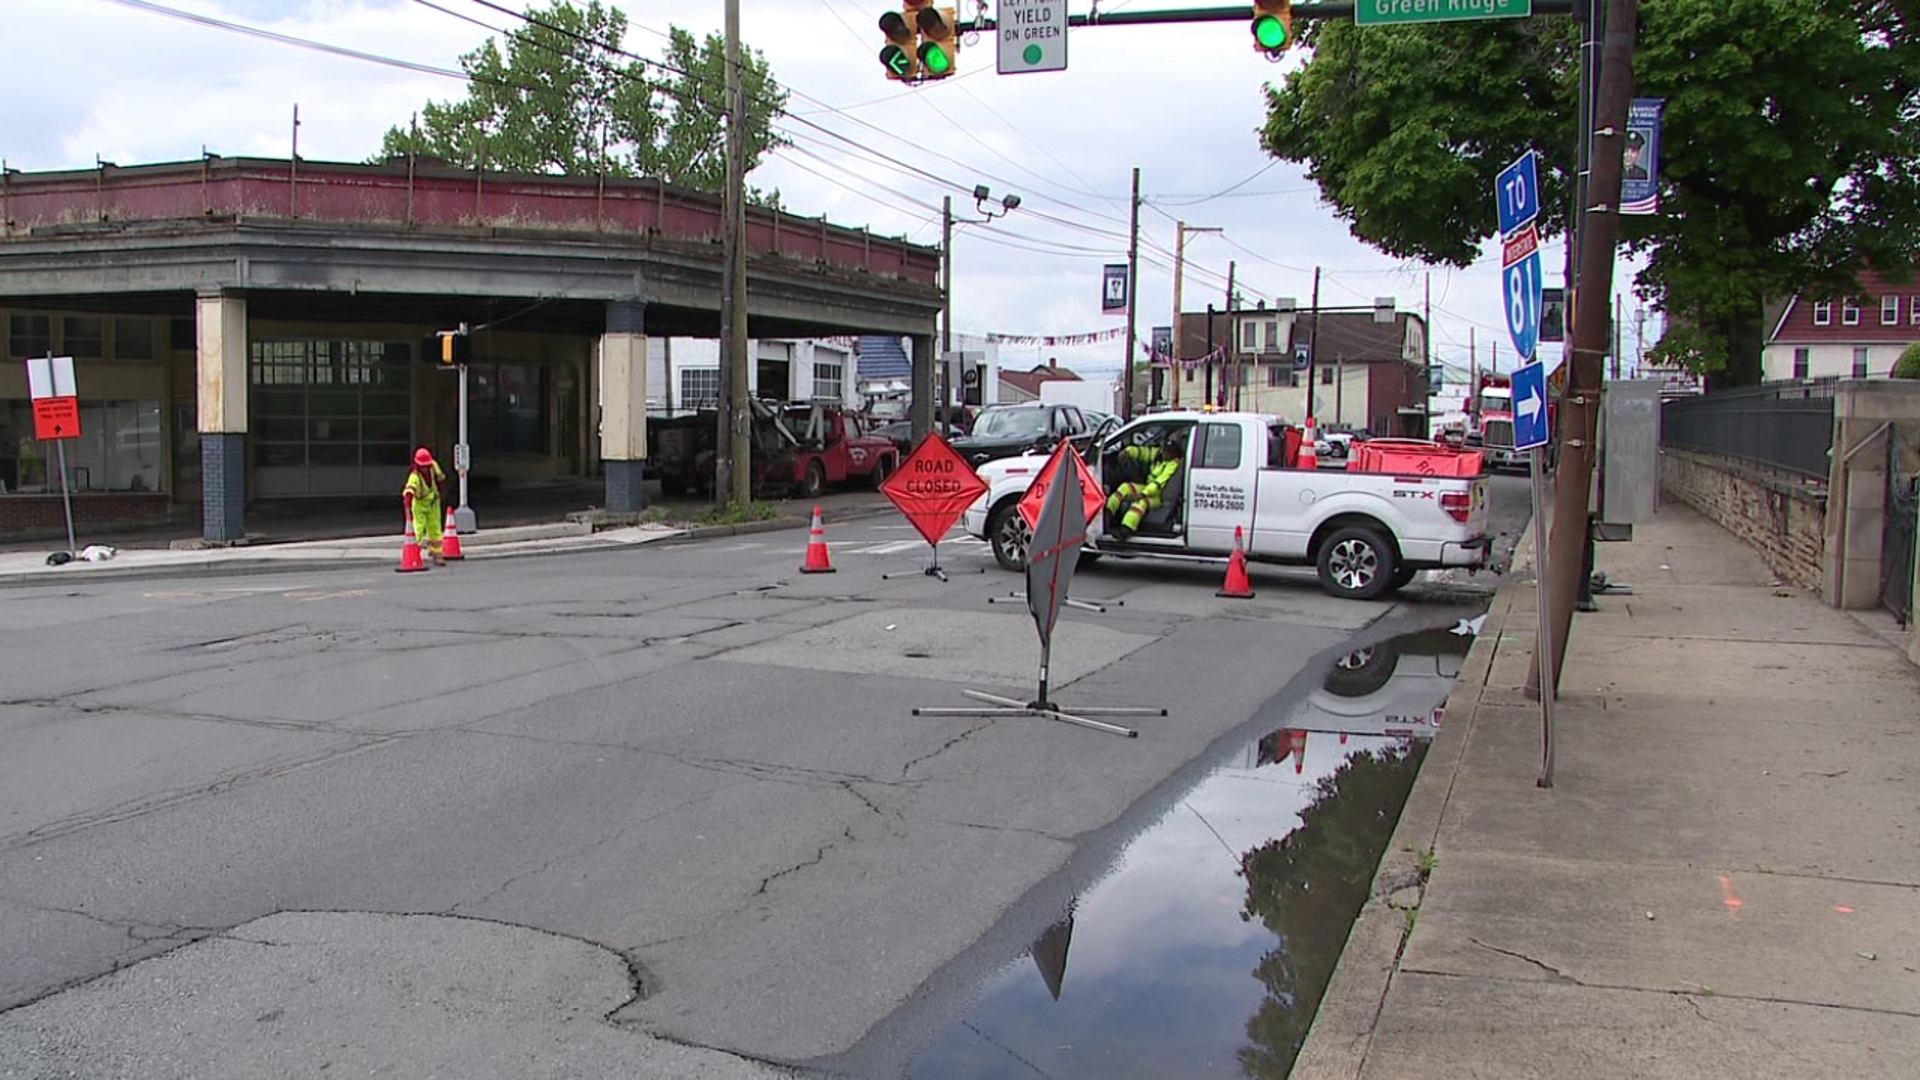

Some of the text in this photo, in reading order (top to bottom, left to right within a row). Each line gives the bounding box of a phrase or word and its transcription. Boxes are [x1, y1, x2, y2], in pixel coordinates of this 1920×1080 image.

[1014, 8, 1051, 24] YIELD
[1005, 26, 1060, 41] ON GREEN
[1505, 173, 1526, 217] TO
[1509, 257, 1536, 336] 81
[914, 459, 954, 474] ROAD
[906, 480, 961, 493] CLOSED
[1393, 490, 1434, 498] STX
